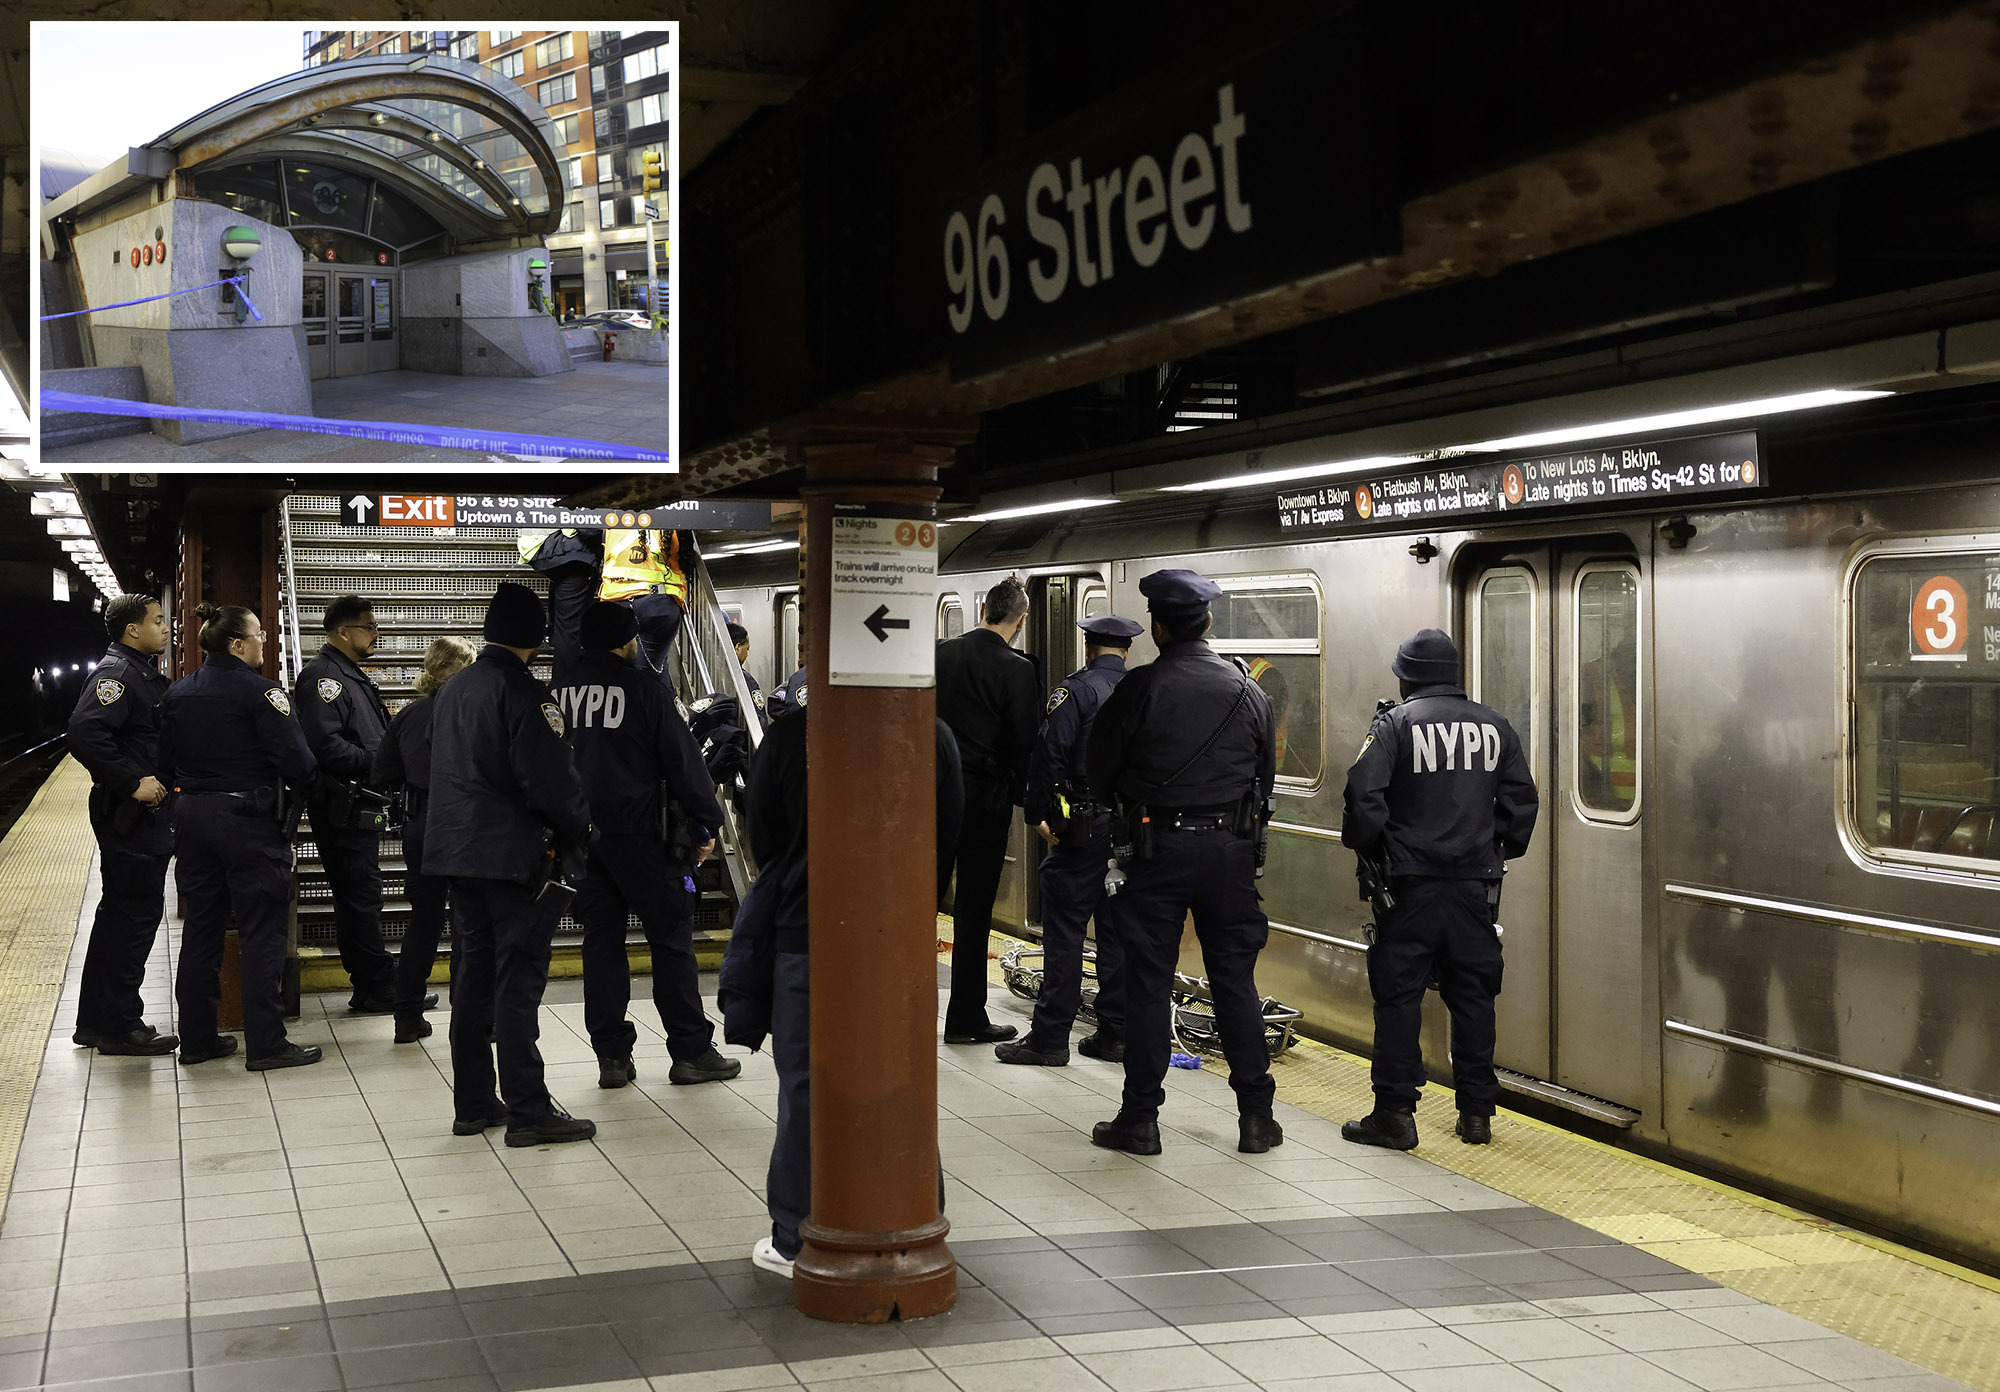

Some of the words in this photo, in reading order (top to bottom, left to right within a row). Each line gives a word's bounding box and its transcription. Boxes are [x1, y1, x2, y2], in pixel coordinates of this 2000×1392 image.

[945, 195, 1010, 333] 96
[1027, 84, 1252, 303] Street
[1523, 461, 1537, 481] To
[1540, 460, 1565, 479] New
[1569, 457, 1596, 476] Lots
[1601, 453, 1619, 474] Av,
[1622, 449, 1661, 472] Bklyn.
[1370, 482, 1382, 499] To
[1383, 476, 1422, 497] Flatbush
[1423, 475, 1438, 495] Av,
[1440, 472, 1469, 492] Bklyn.
[1508, 473, 1519, 495] 3
[1525, 483, 1550, 503] Late
[1553, 478, 1588, 503] nights
[1592, 477, 1606, 495] to
[1608, 473, 1648, 494] Times
[1651, 465, 1694, 492] Sq-42
[1699, 464, 1715, 485] St
[1720, 461, 1741, 482] for
[382, 496, 447, 520] Exit
[1278, 491, 1317, 510] Downtown
[1319, 490, 1326, 499] &
[1327, 488, 1351, 507] Bklyn
[1359, 491, 1368, 512] 2
[1372, 501, 1392, 519] Late
[1394, 498, 1424, 518] nights
[1425, 499, 1437, 512] on
[1438, 493, 1462, 512] local
[1463, 489, 1490, 508] track
[456, 510, 512, 526] Uptown
[515, 511, 527, 524] &
[529, 511, 557, 524] The
[560, 511, 602, 525] Bronx
[847, 519, 877, 530] Nights
[1280, 513, 1292, 527] via
[1293, 511, 1299, 525] 7
[1301, 511, 1310, 525] Av
[1312, 507, 1344, 527] Express
[835, 560, 862, 572] Trains
[864, 562, 879, 572] will
[880, 563, 905, 573] arrive
[906, 565, 917, 573] on
[917, 565, 934, 575] local
[834, 573, 859, 584] track
[859, 575, 904, 586] overnight
[1925, 589, 1957, 649] 3
[1412, 721, 1501, 774] NYPD
